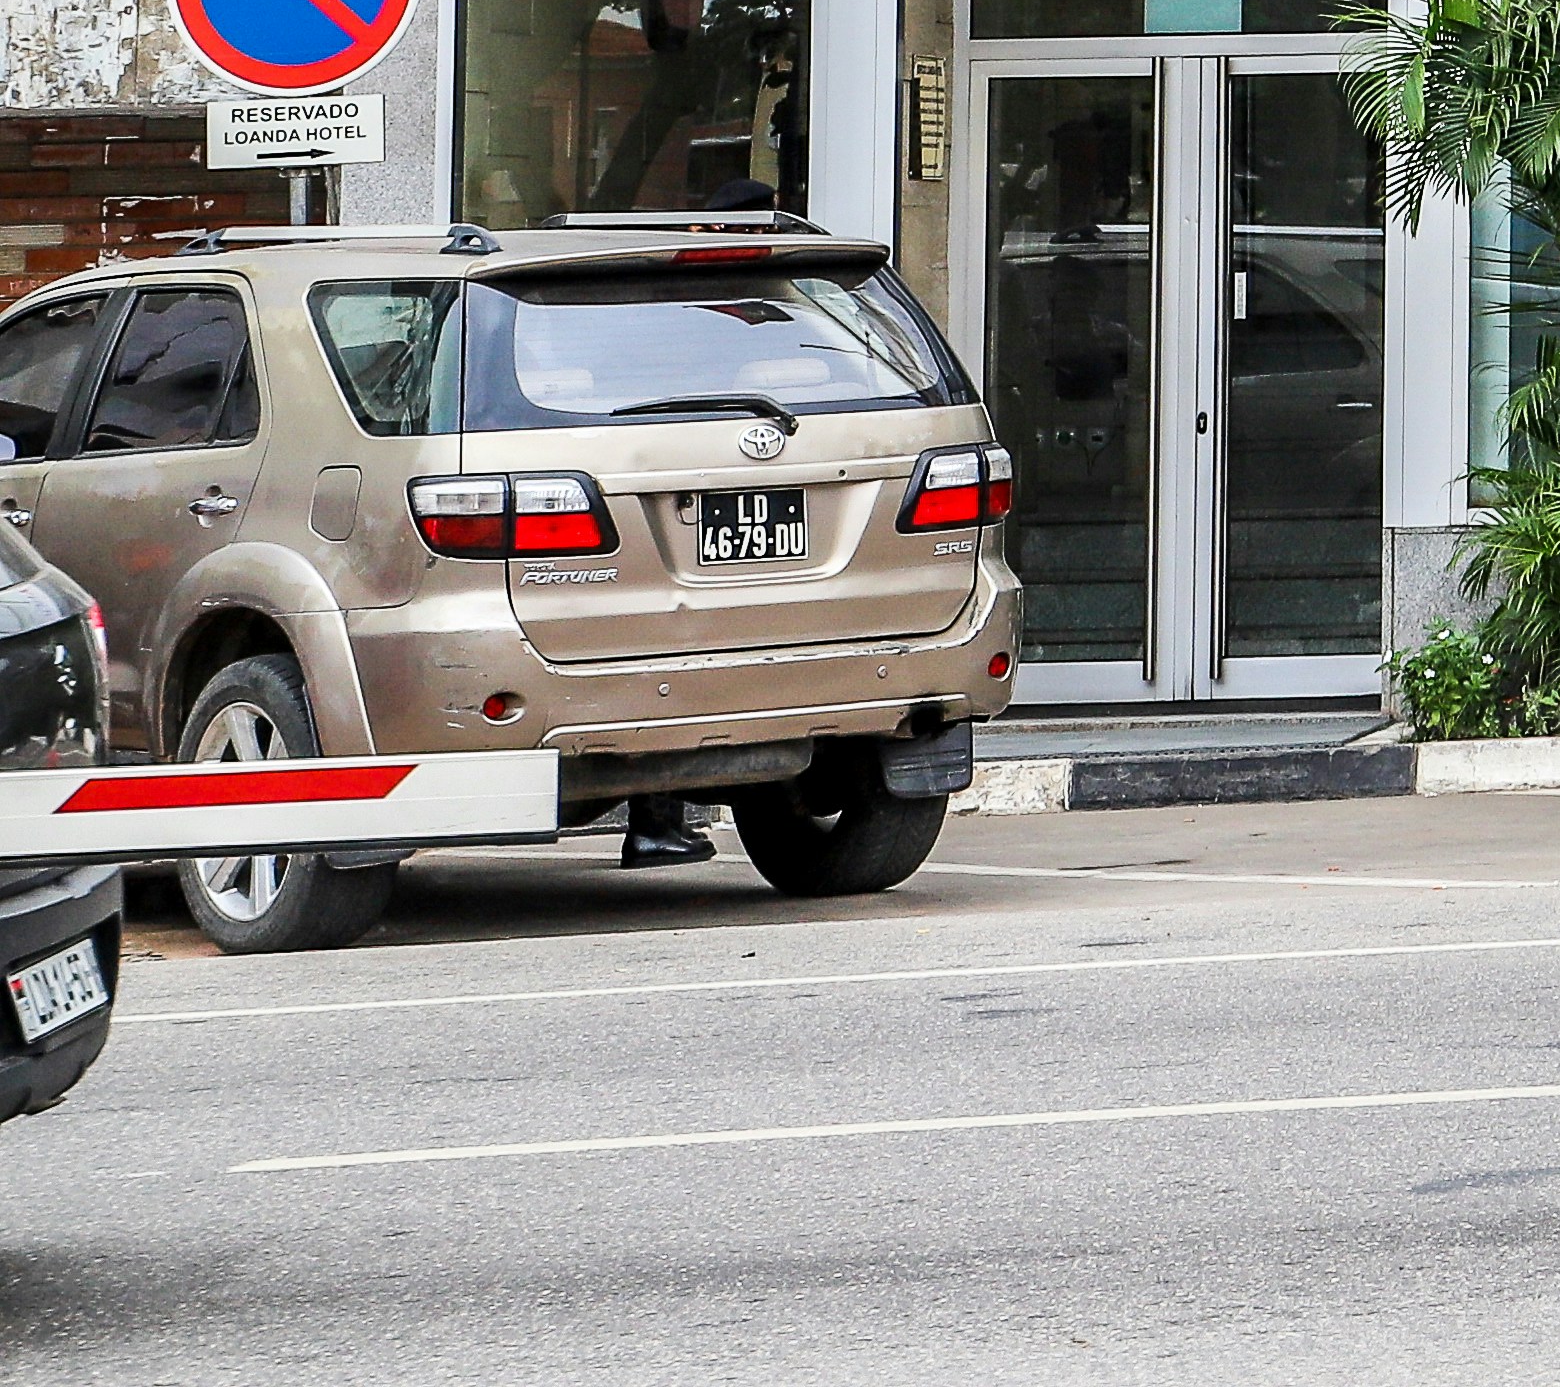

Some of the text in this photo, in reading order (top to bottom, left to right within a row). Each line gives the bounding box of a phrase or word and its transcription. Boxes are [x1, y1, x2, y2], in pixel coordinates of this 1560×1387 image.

[231, 103, 360, 124] RESERVADO
[223, 125, 367, 146] LOANDA HOTEL
[737, 494, 769, 524] LD
[703, 522, 804, 560] 46-79-DU
[519, 568, 618, 587] FORTUNER
